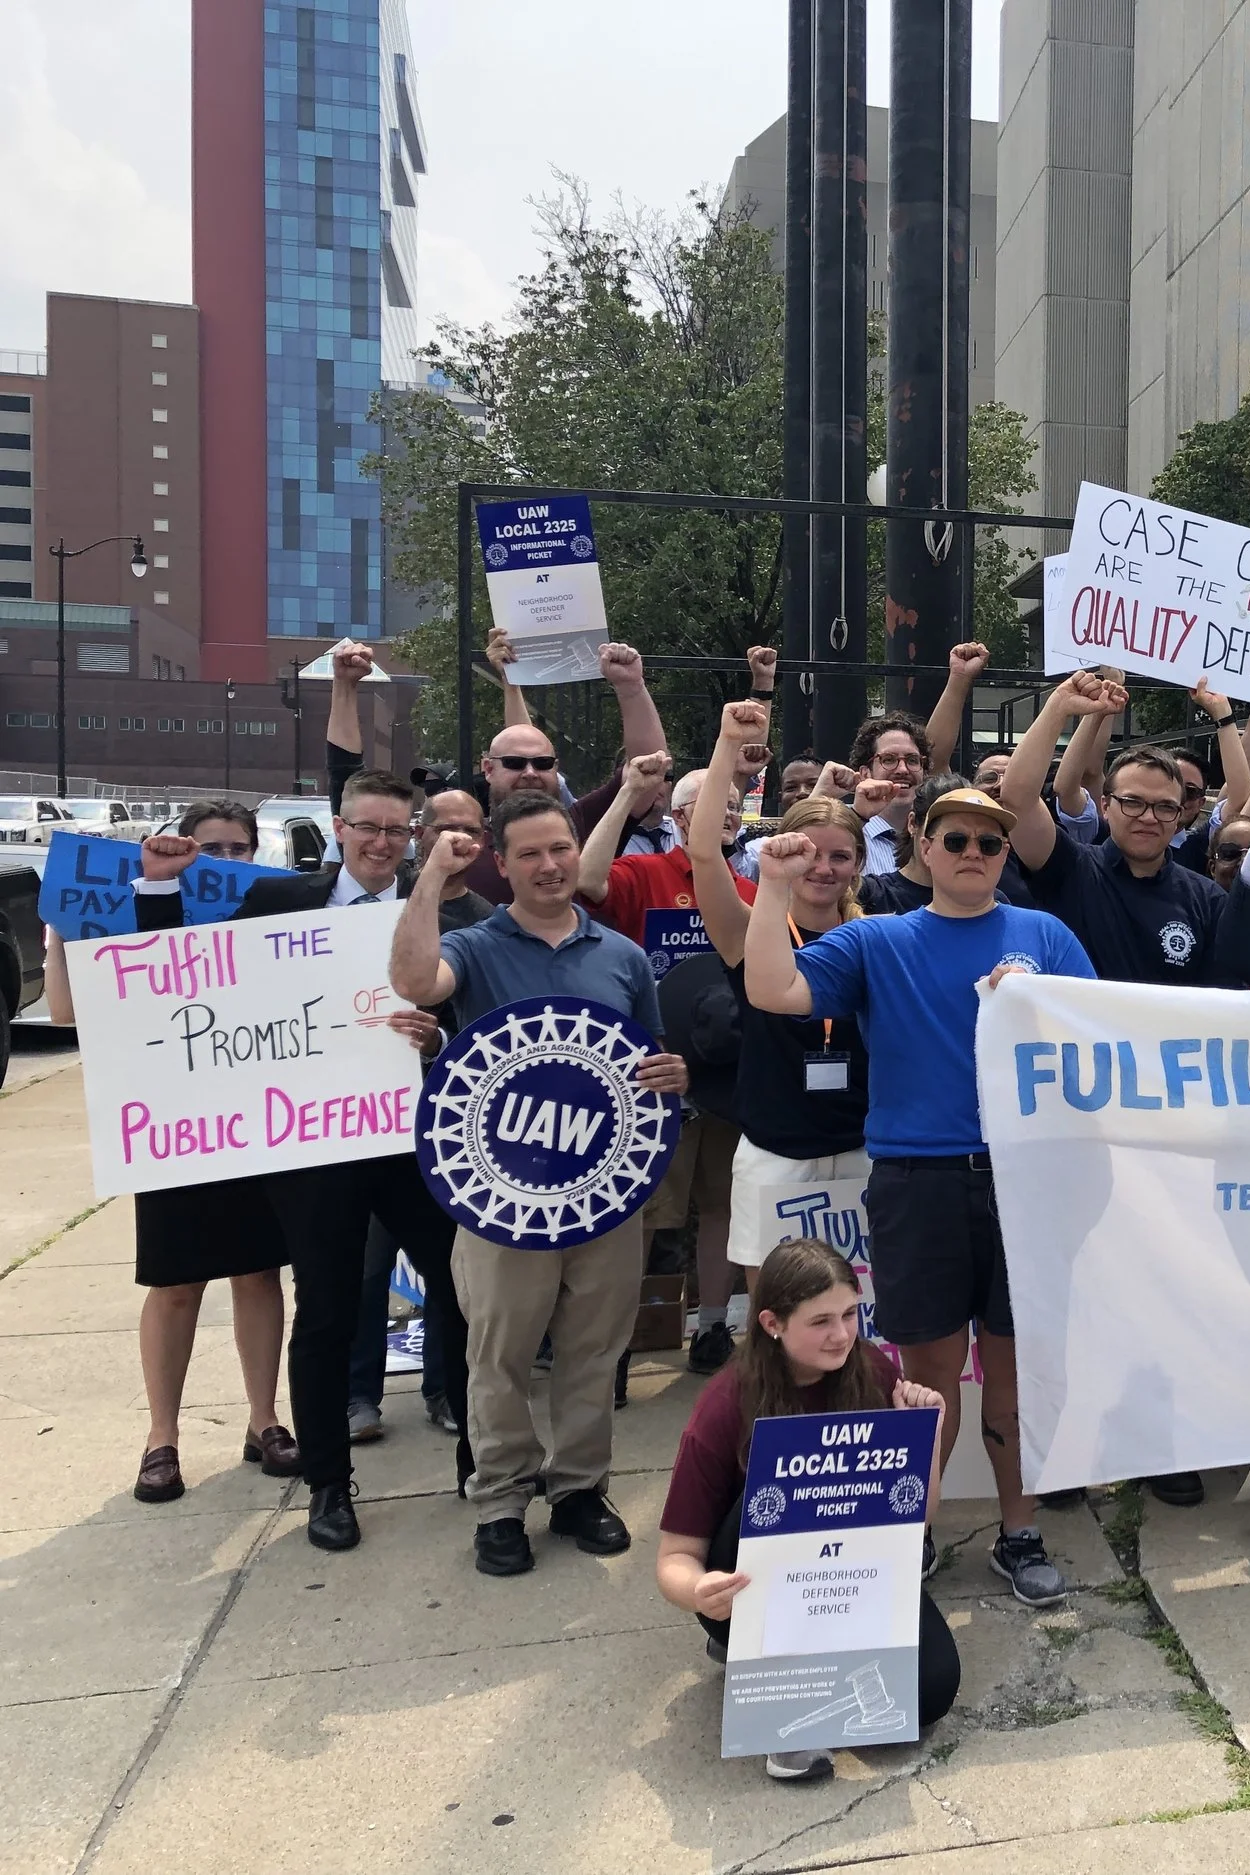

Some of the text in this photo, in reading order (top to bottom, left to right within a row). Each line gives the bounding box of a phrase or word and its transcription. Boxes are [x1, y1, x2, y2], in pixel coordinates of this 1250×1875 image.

[517, 505, 549, 520] UAW
[495, 519, 577, 539] LOCAL 2325
[1099, 499, 1208, 567] CASE
[510, 539, 566, 551] INFORMATIONAL
[527, 551, 553, 560] PICKET
[536, 574, 550, 583] AT
[1095, 553, 1143, 584] ARE
[1177, 575, 1226, 604] THE
[518, 593, 574, 606] NEIGHBORHOOD
[530, 604, 565, 615] DEFENDER
[536, 614, 563, 623] SERVICE
[1071, 585, 1198, 663] QUALITY
[75, 844, 245, 904] LIBL
[59, 888, 128, 916] PAY
[661, 932, 709, 946] LOCAL
[93, 929, 237, 1000] Fulfill
[264, 927, 333, 959] THE
[354, 986, 390, 1014] OF
[121, 1086, 412, 1165] PUBLIC DEFENSE
[466, 1044, 634, 1201] UNITED AUTOMOBILE, AEROSPACE AND AGRICULTURAL IMPLEMENT WORKERS OF AMERICA
[496, 1092, 606, 1156] UAW
[821, 1422, 874, 1447] UAW
[775, 1448, 908, 1479] LOCAL 2325
[793, 1481, 884, 1501] INFORMATIONAL
[816, 1501, 858, 1518] PICKET
[818, 1542, 844, 1559] AT
[786, 1568, 878, 1584] NEIGHBORHOOD
[802, 1586, 859, 1600] DEFENDER
[807, 1602, 851, 1617] SERVICE
